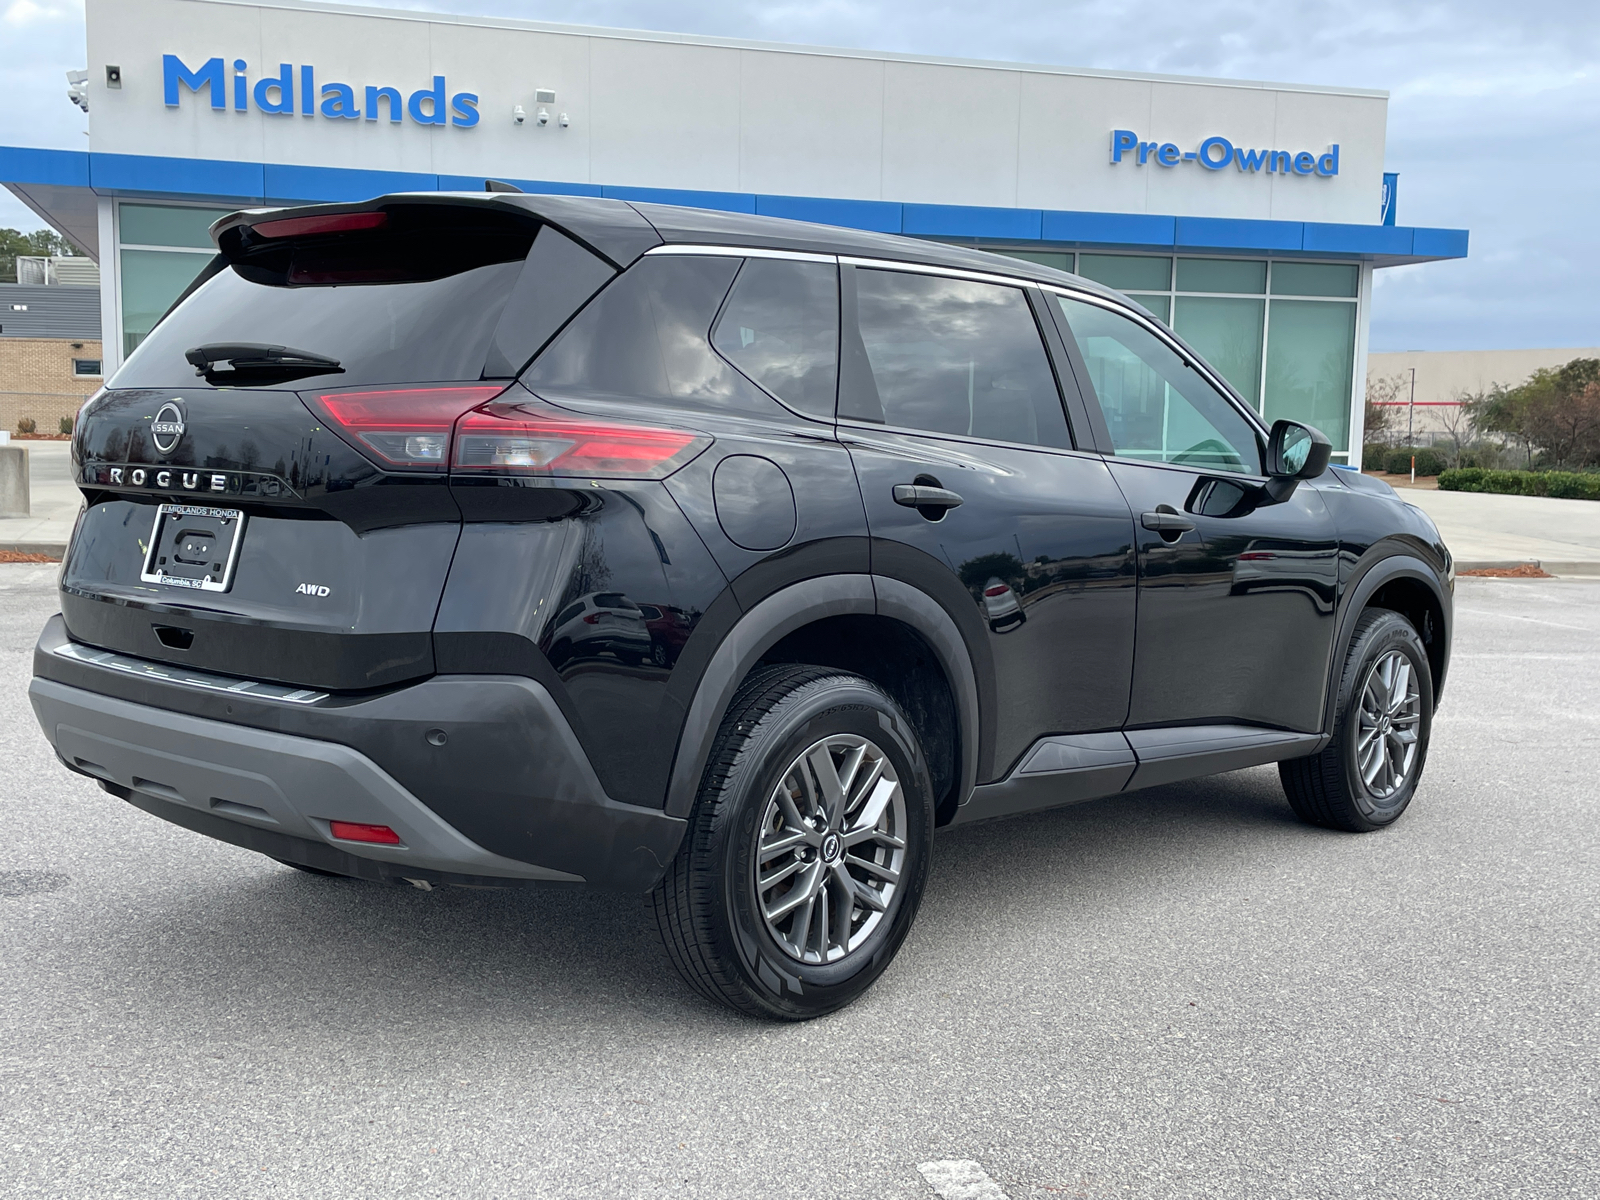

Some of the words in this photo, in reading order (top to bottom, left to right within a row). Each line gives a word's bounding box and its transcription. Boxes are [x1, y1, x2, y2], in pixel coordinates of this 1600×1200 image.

[163, 54, 480, 127] Midlands
[1110, 129, 1340, 177] Pre-Owned
[110, 468, 226, 490] ROGUE
[168, 505, 207, 515] MIDLANDS
[209, 508, 238, 518] HONDA
[192, 580, 203, 588] SC
[295, 583, 330, 597] AWD
